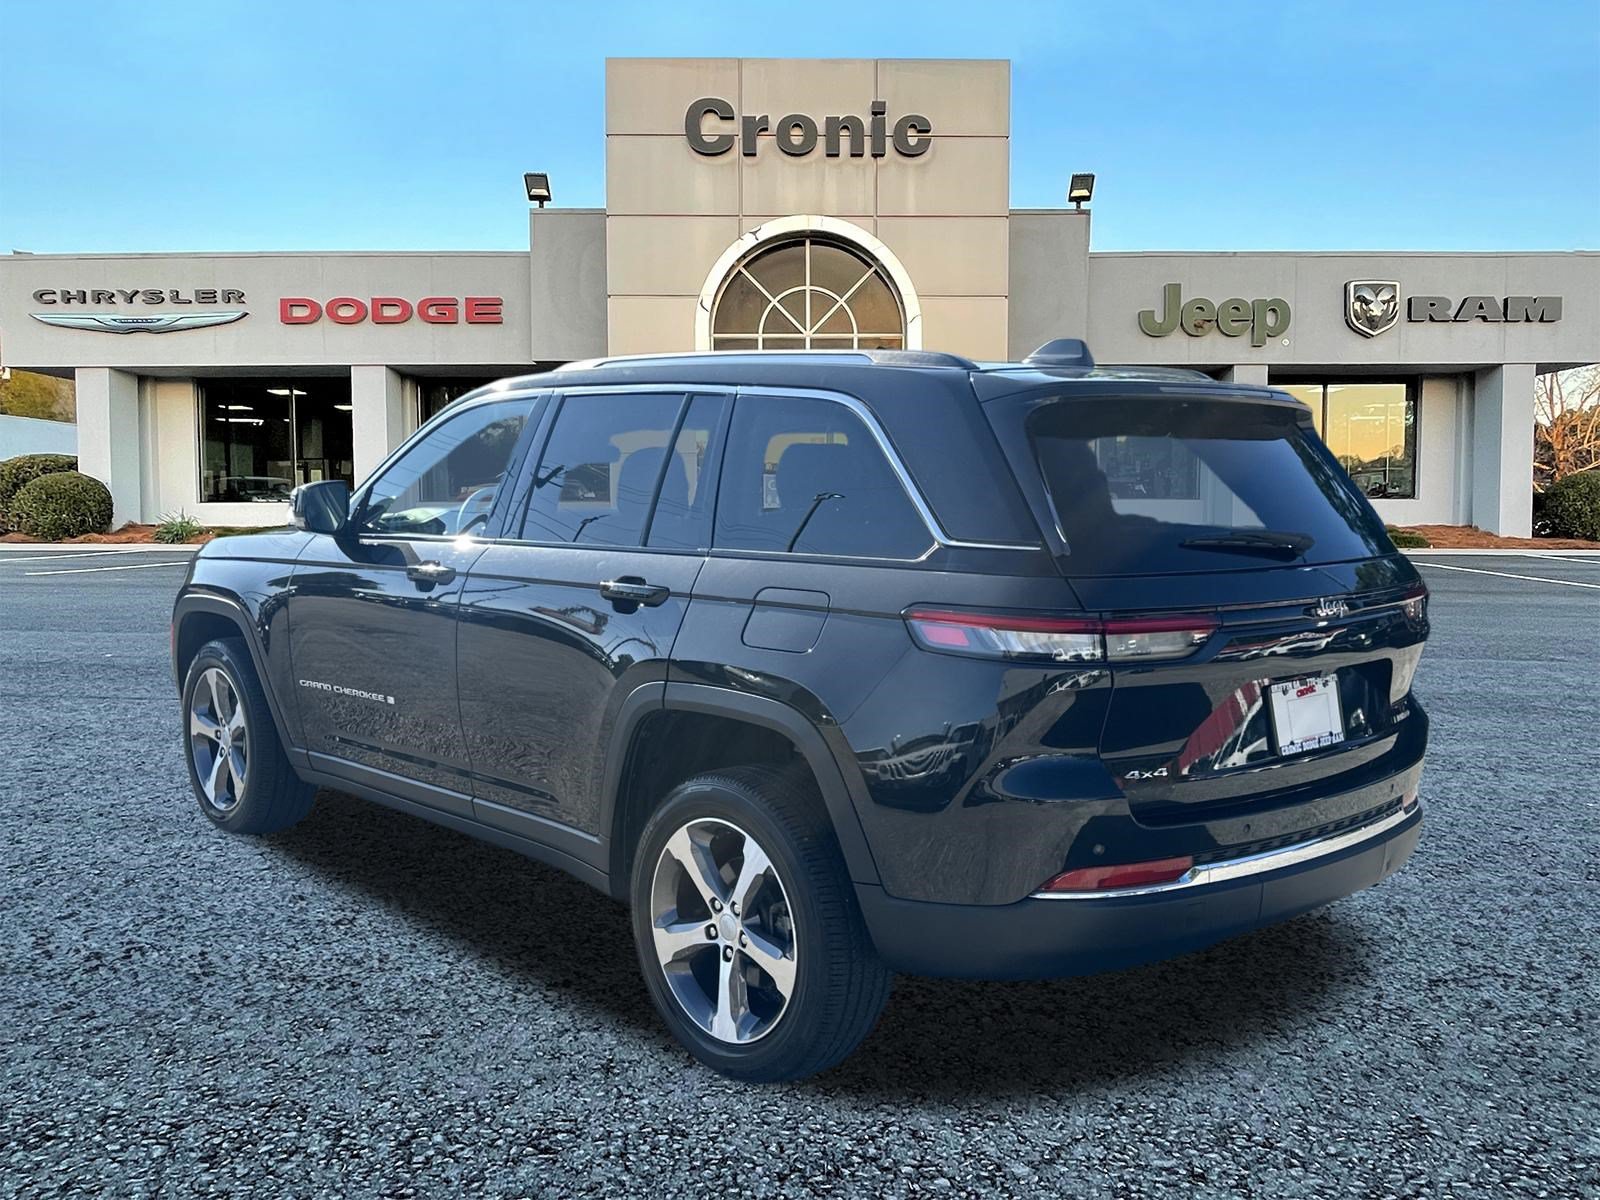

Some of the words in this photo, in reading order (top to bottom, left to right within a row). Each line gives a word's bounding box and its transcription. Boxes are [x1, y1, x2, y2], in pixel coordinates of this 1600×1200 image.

[685, 97, 932, 157] Cronic
[32, 288, 248, 305] CHRYSLER
[280, 296, 503, 325] DODGE
[1138, 283, 1291, 347] Jeep
[1407, 296, 1563, 323] RAM
[1317, 598, 1349, 618] Jeep
[299, 679, 332, 691] GRAND
[333, 685, 385, 702] CHEROKEE
[1124, 767, 1169, 780] 4x4
